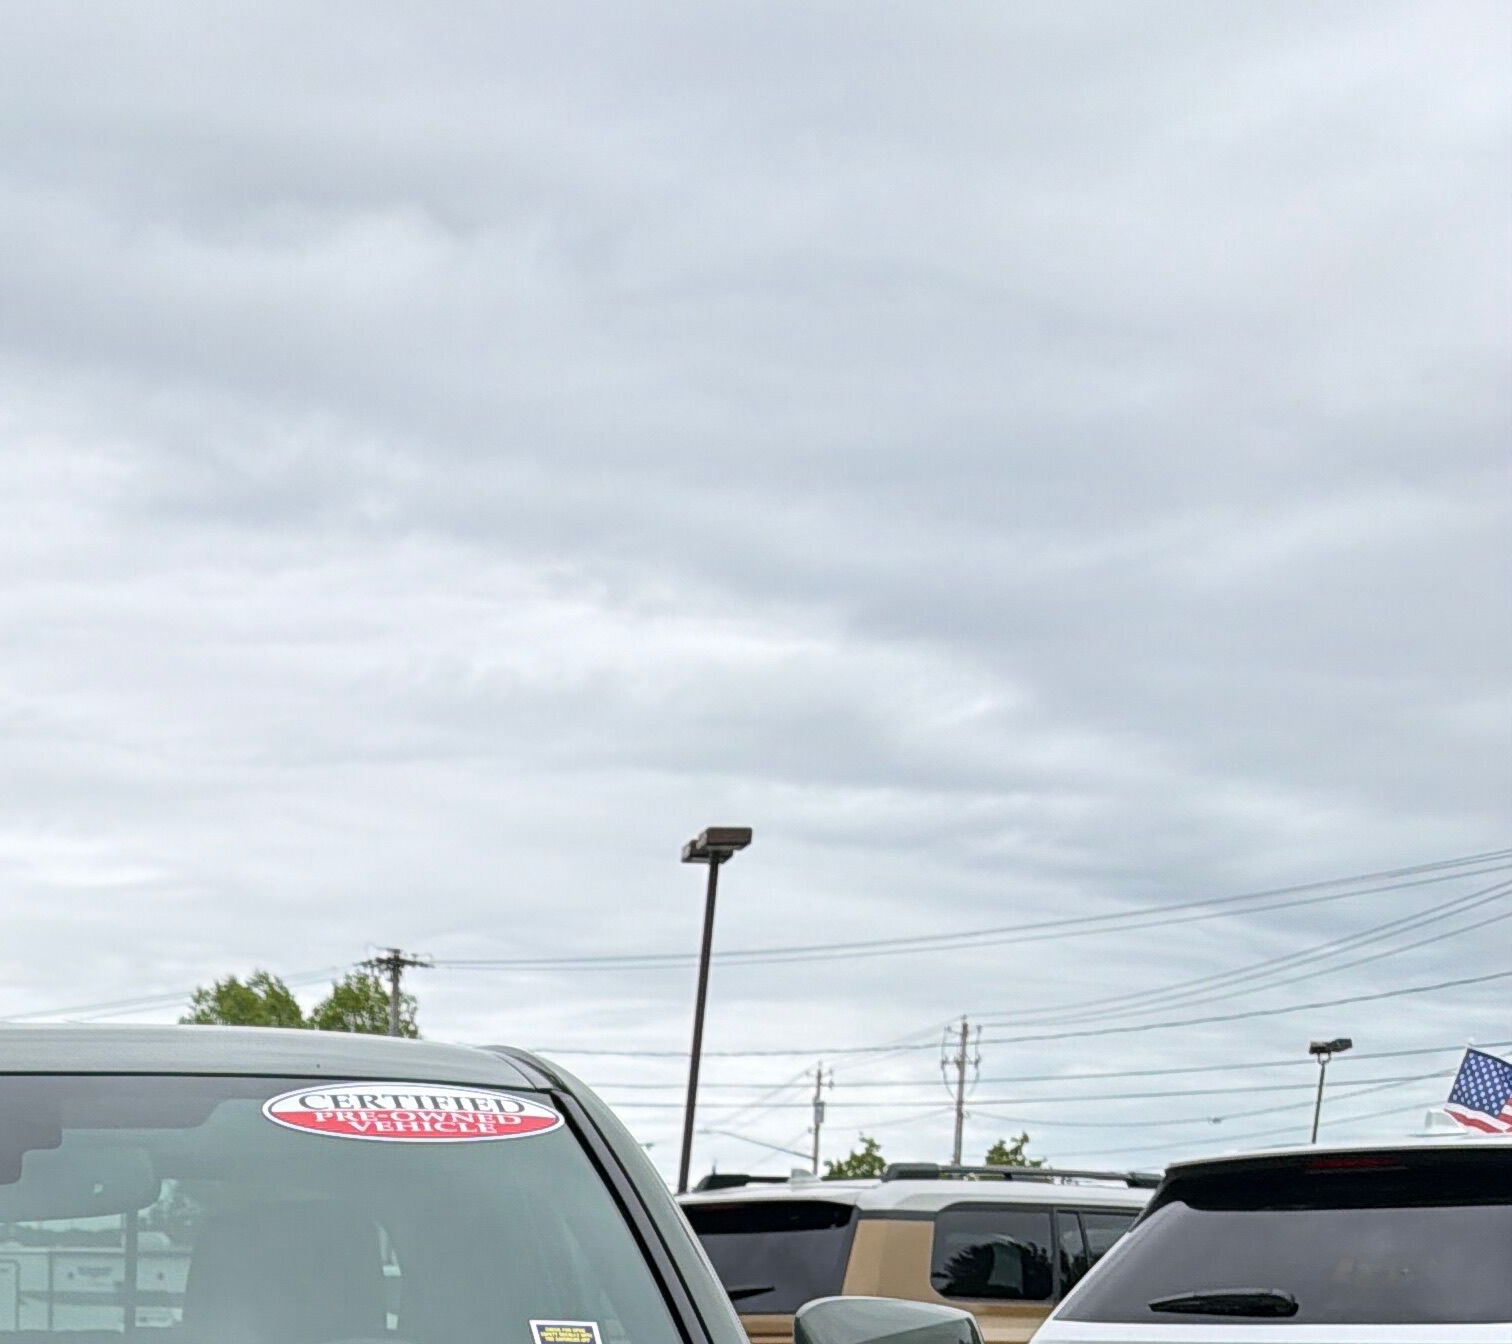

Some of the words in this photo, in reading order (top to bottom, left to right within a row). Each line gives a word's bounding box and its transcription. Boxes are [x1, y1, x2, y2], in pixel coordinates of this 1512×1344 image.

[299, 1093, 525, 1114] CERTIFIED
[313, 1111, 522, 1125] PRE-OWNED
[348, 1121, 497, 1134] VEHICLE
